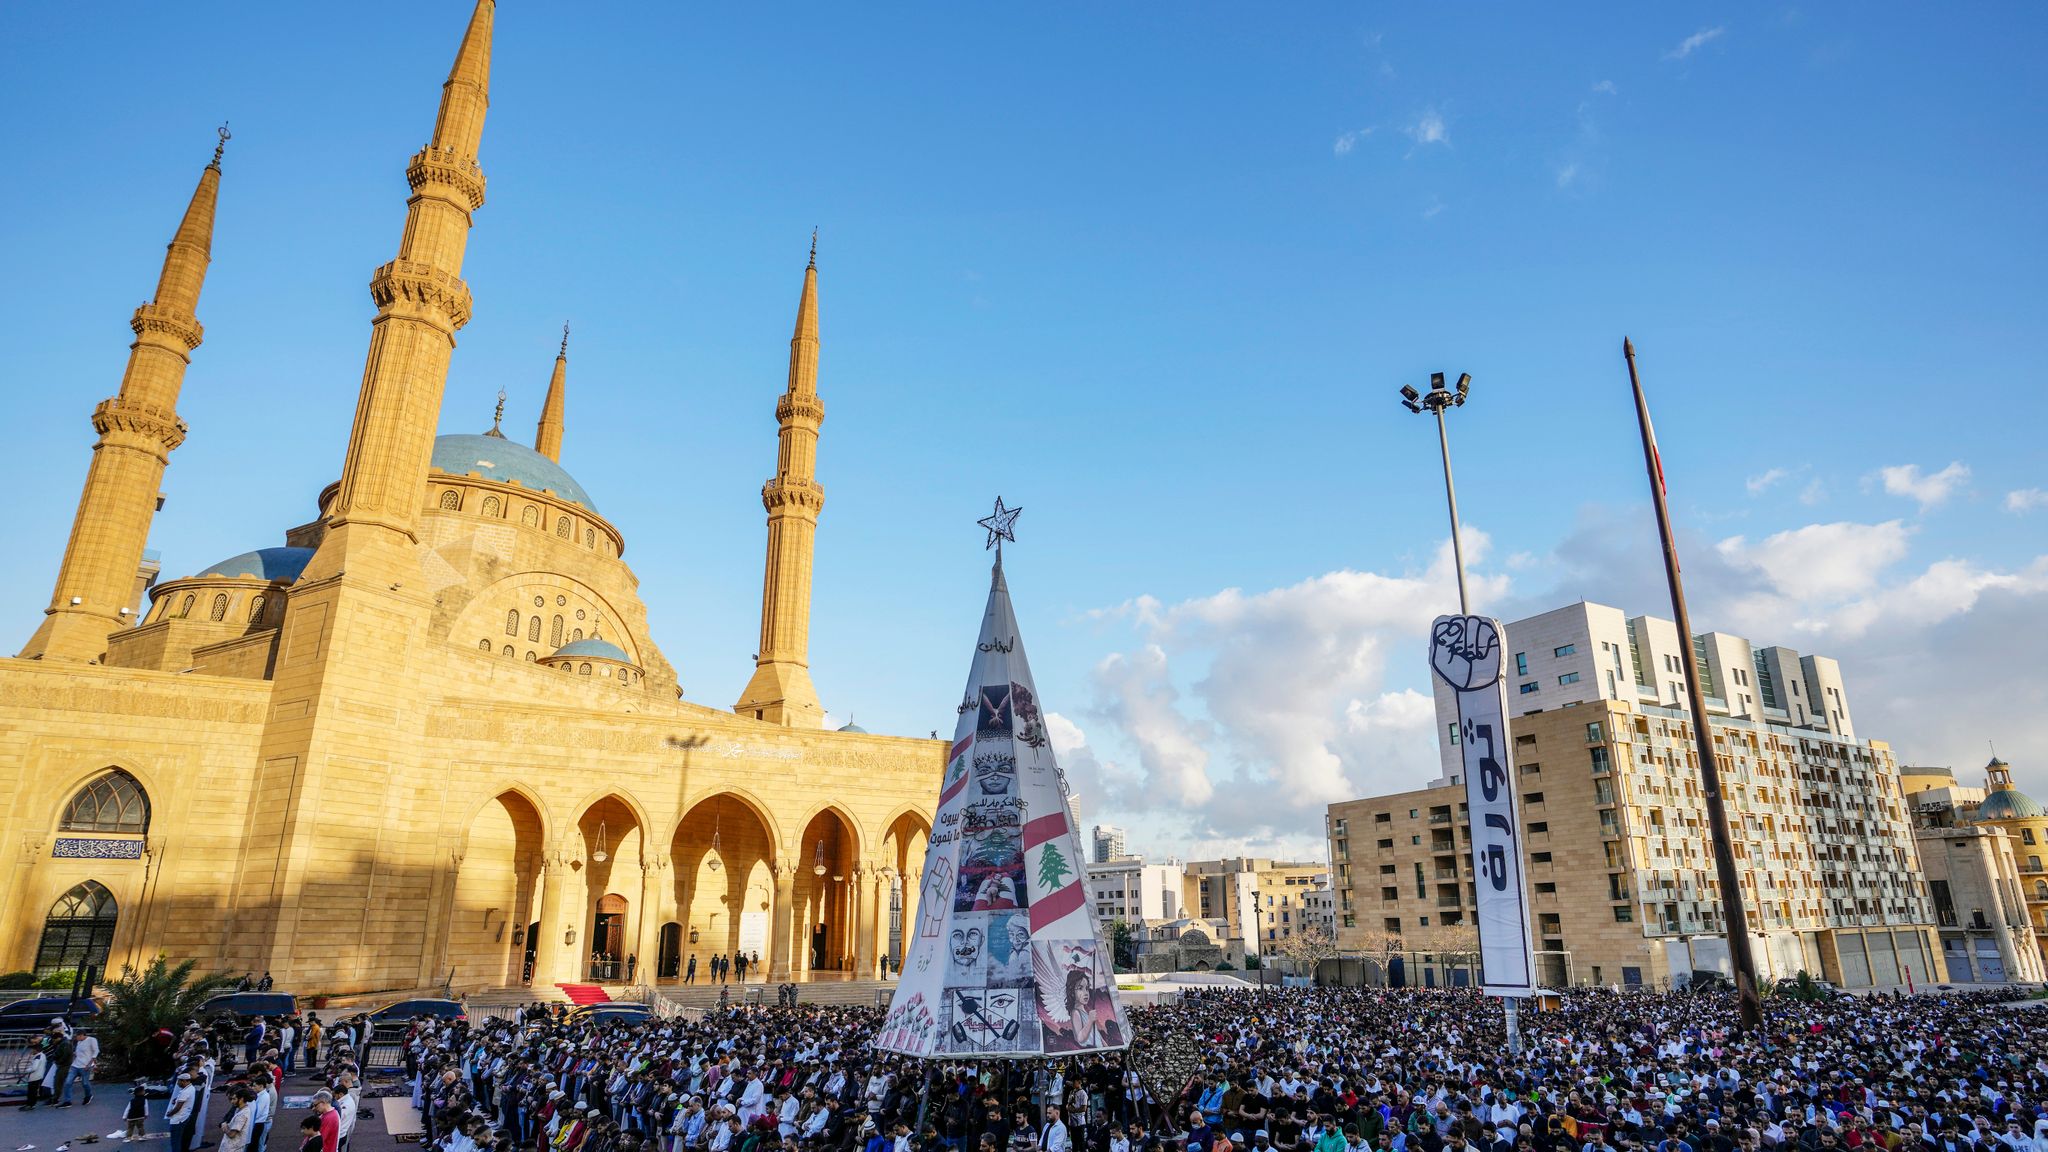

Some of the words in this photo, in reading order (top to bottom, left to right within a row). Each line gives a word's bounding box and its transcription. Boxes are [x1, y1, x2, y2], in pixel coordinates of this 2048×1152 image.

[978, 636, 1014, 654] لبنان
[1463, 717, 1511, 892] ثورة
[941, 812, 959, 827] بيروت
[930, 829, 952, 847] بتموت
[953, 828, 960, 841] ما
[917, 944, 934, 973] ثورة
[963, 1014, 1005, 1033] سلمية
